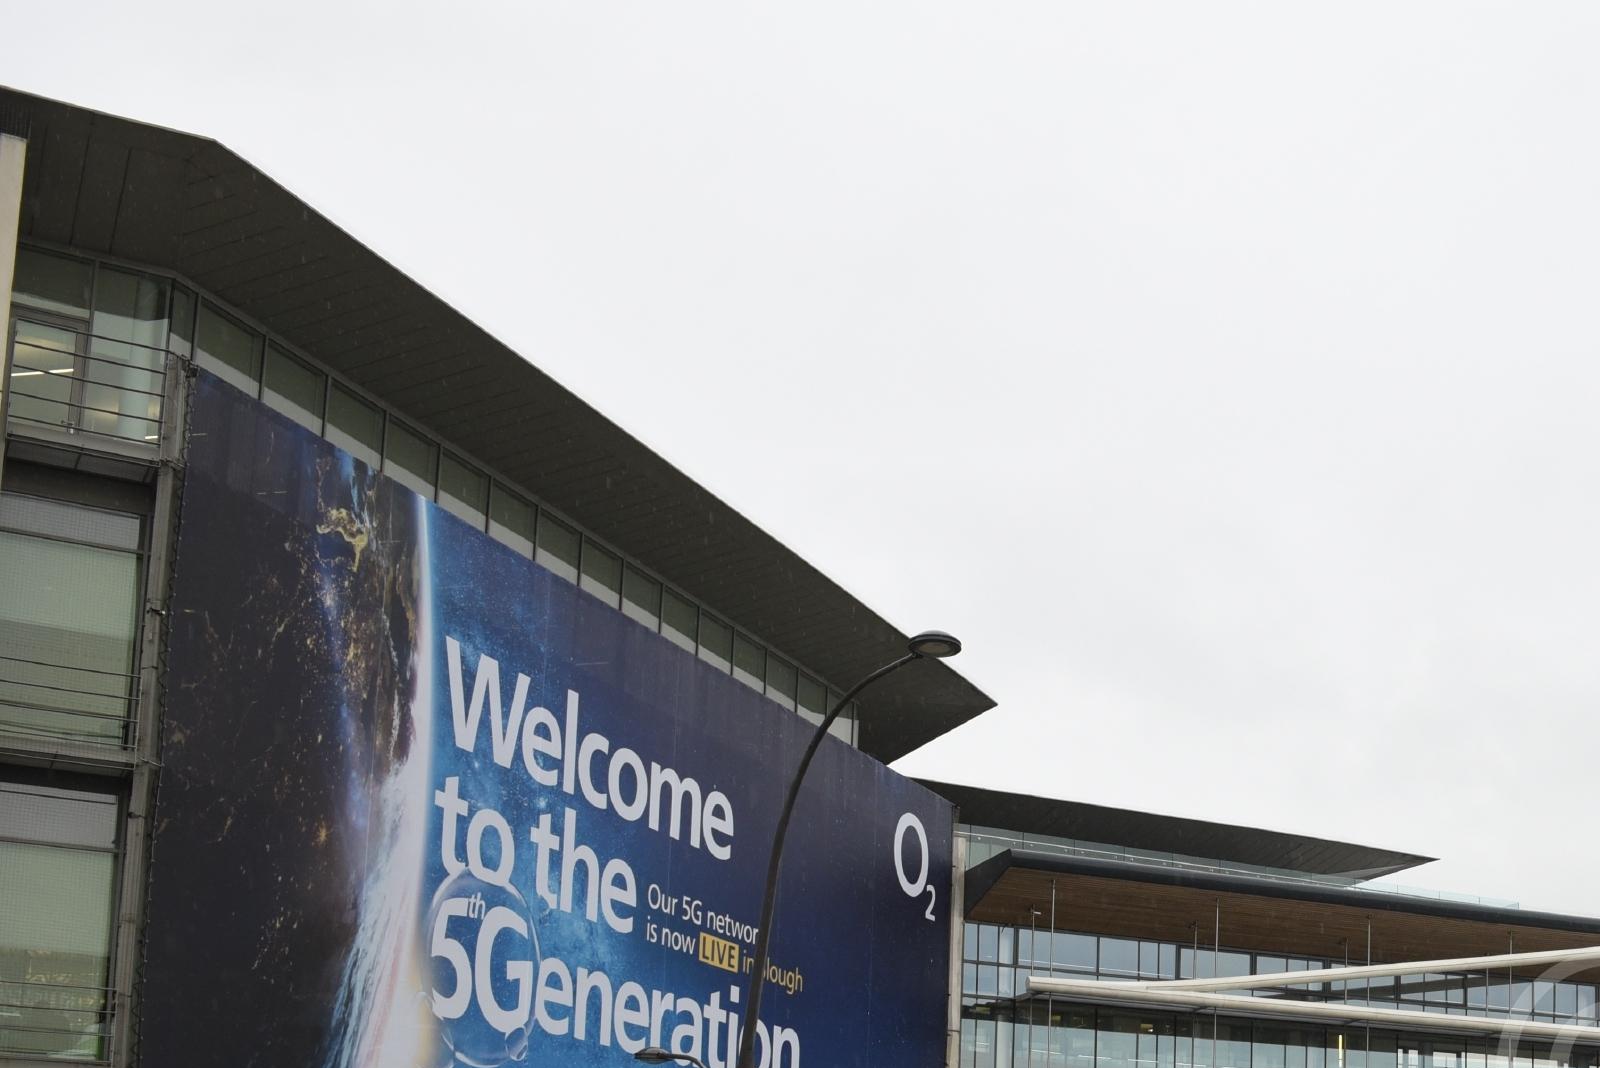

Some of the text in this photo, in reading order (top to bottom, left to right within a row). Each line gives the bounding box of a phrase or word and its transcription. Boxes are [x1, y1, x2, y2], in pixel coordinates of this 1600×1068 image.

[446, 636, 734, 861] Welcome
[435, 776, 638, 934] to the
[647, 883, 760, 946] Our 5G networ
[646, 915, 658, 944] is
[661, 928, 696, 955] now
[701, 935, 736, 970] LIVE
[763, 956, 803, 995] lough
